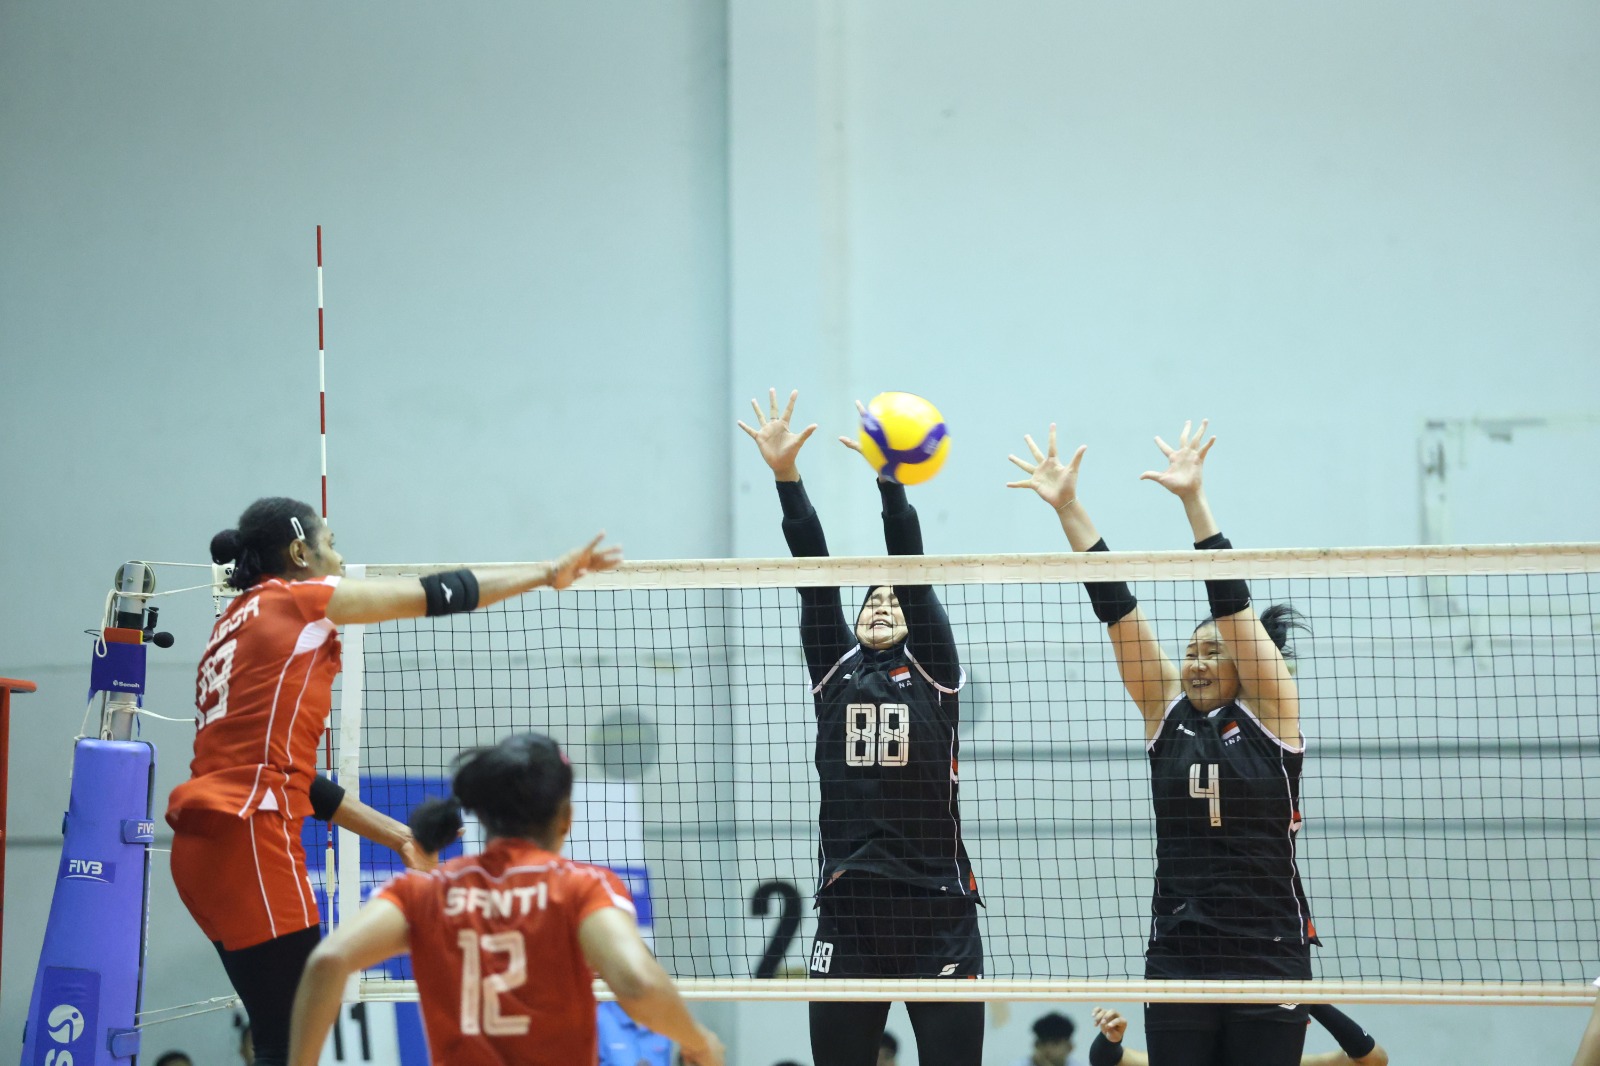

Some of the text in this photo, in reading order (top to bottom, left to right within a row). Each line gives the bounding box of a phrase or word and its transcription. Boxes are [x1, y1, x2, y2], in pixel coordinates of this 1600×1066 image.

[846, 703, 910, 767] 88
[1224, 735, 1242, 747] INA
[1189, 763, 1222, 827] 4
[443, 882, 548, 919] SANTI
[457, 928, 532, 1036] 12
[811, 940, 834, 974] 88
